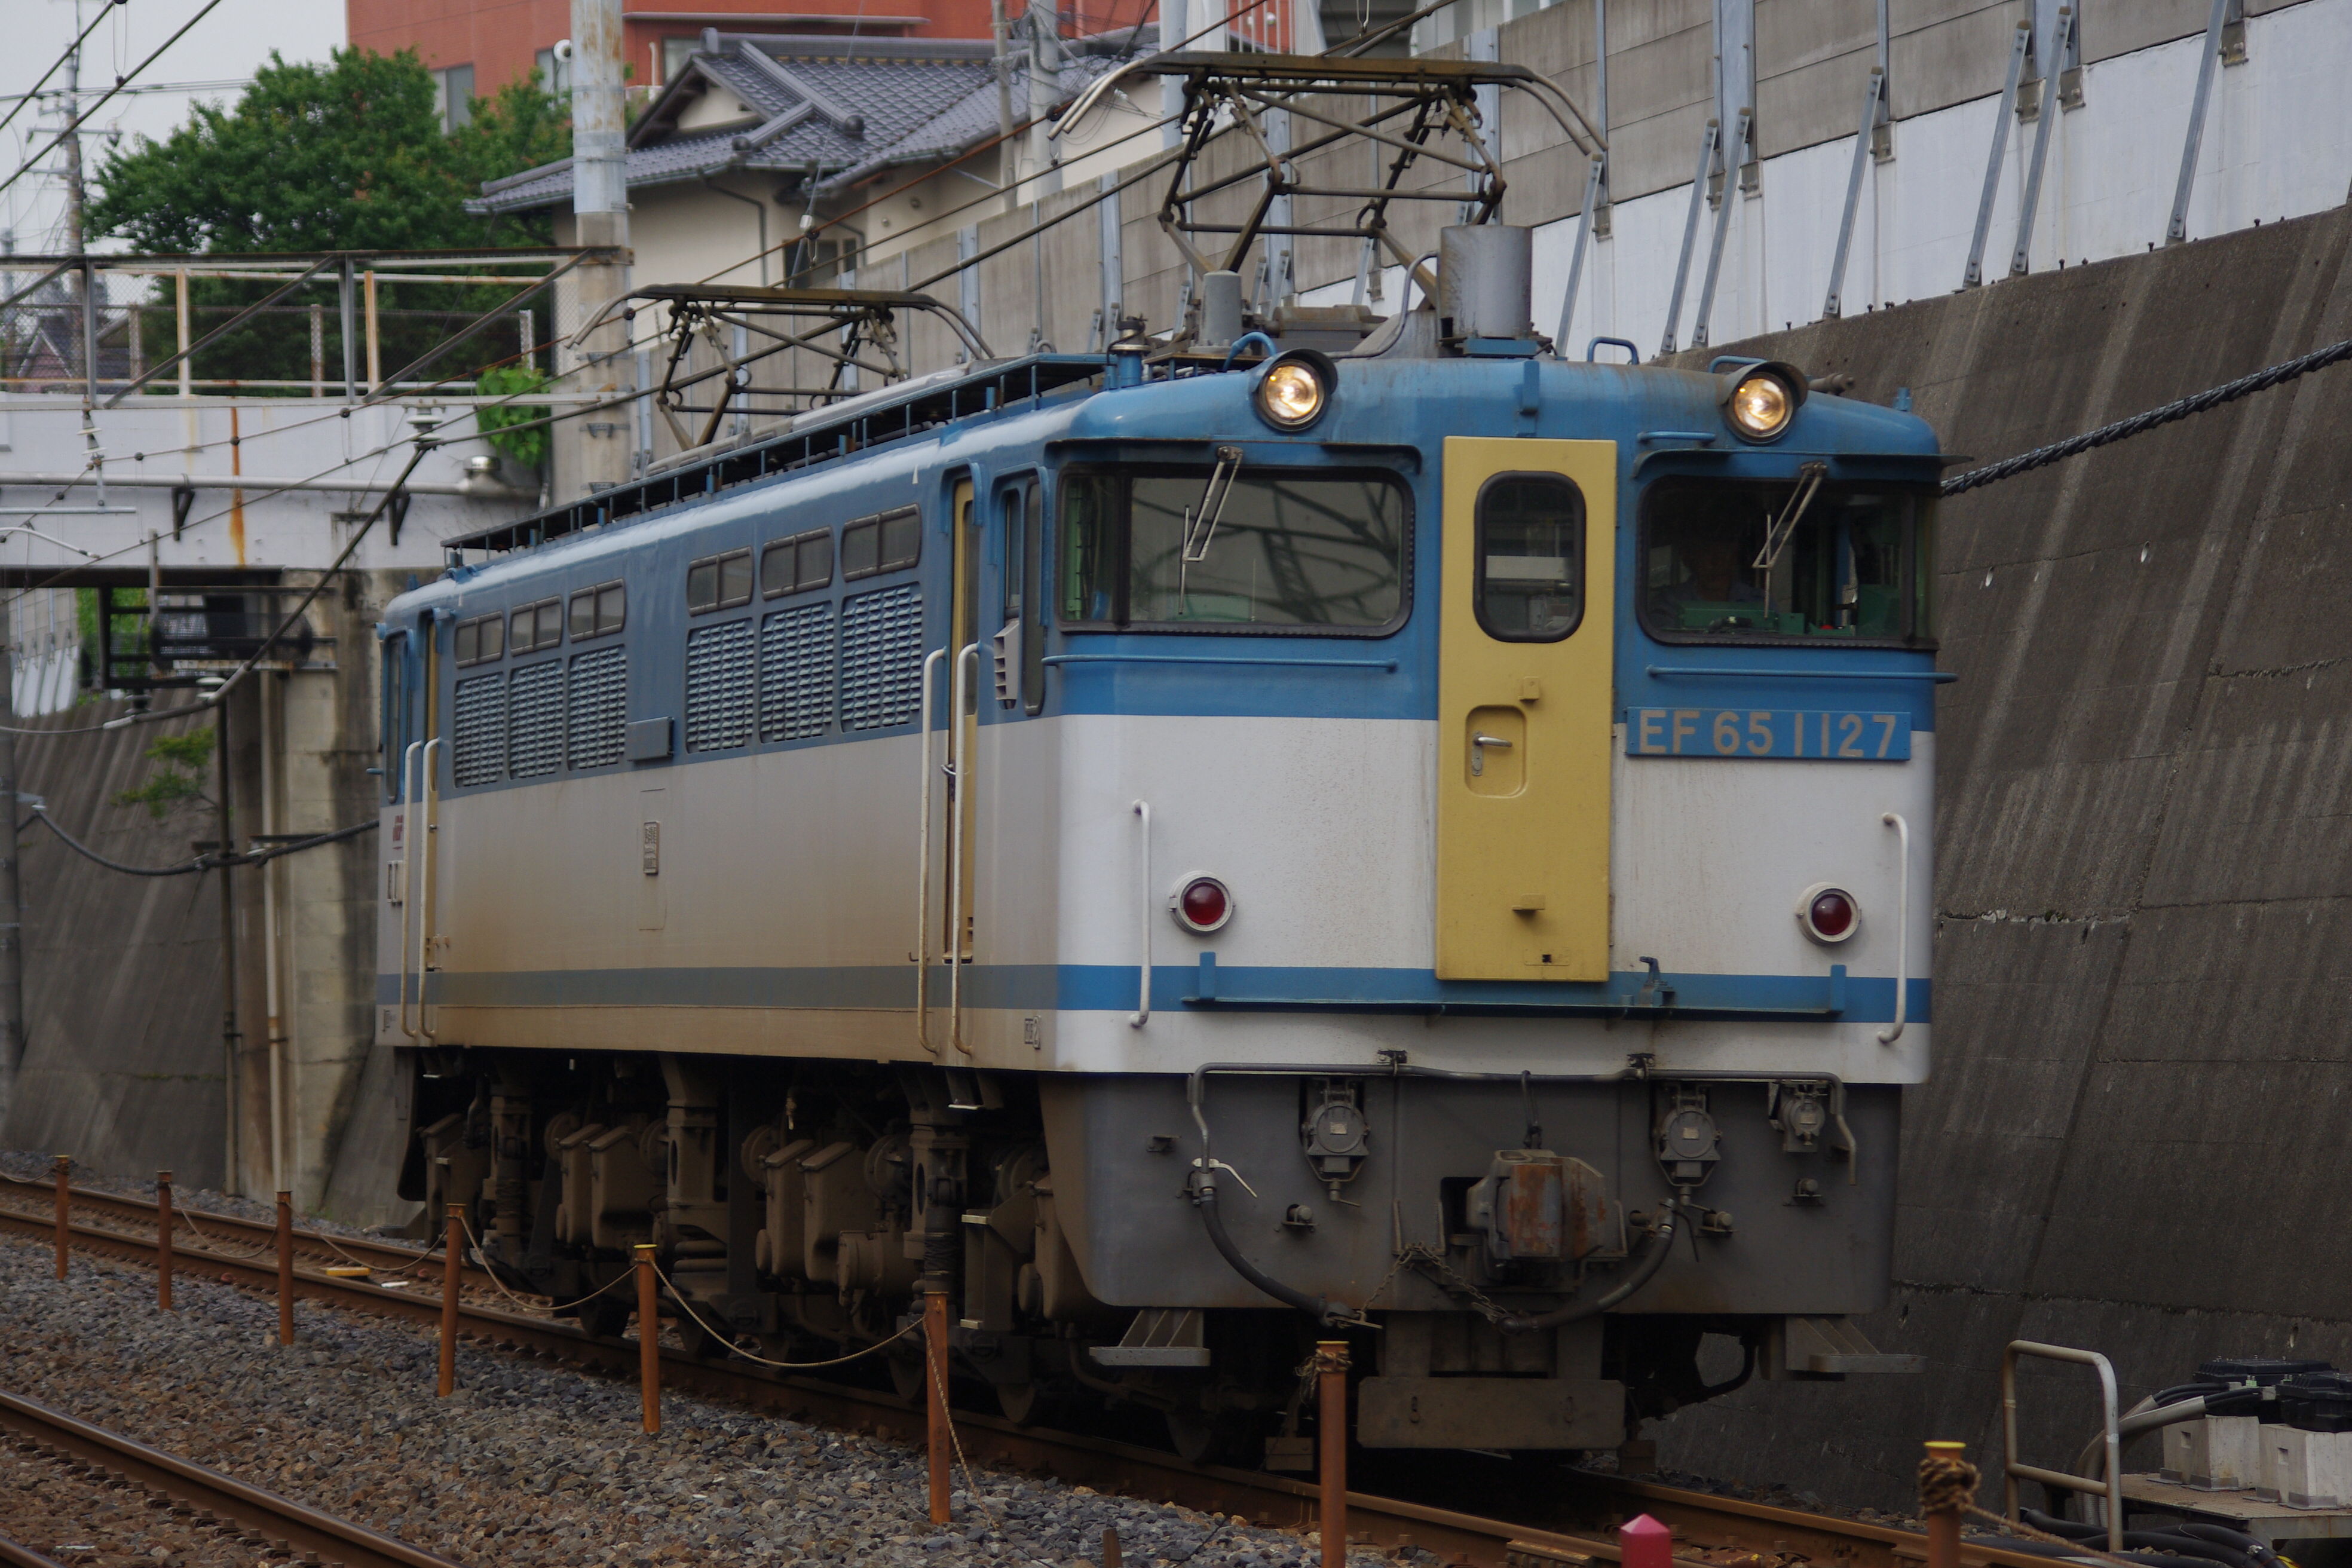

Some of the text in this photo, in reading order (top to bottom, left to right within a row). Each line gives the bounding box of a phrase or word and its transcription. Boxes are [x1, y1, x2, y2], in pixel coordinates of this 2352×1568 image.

[1639, 710, 1896, 758] EF 65 1127
